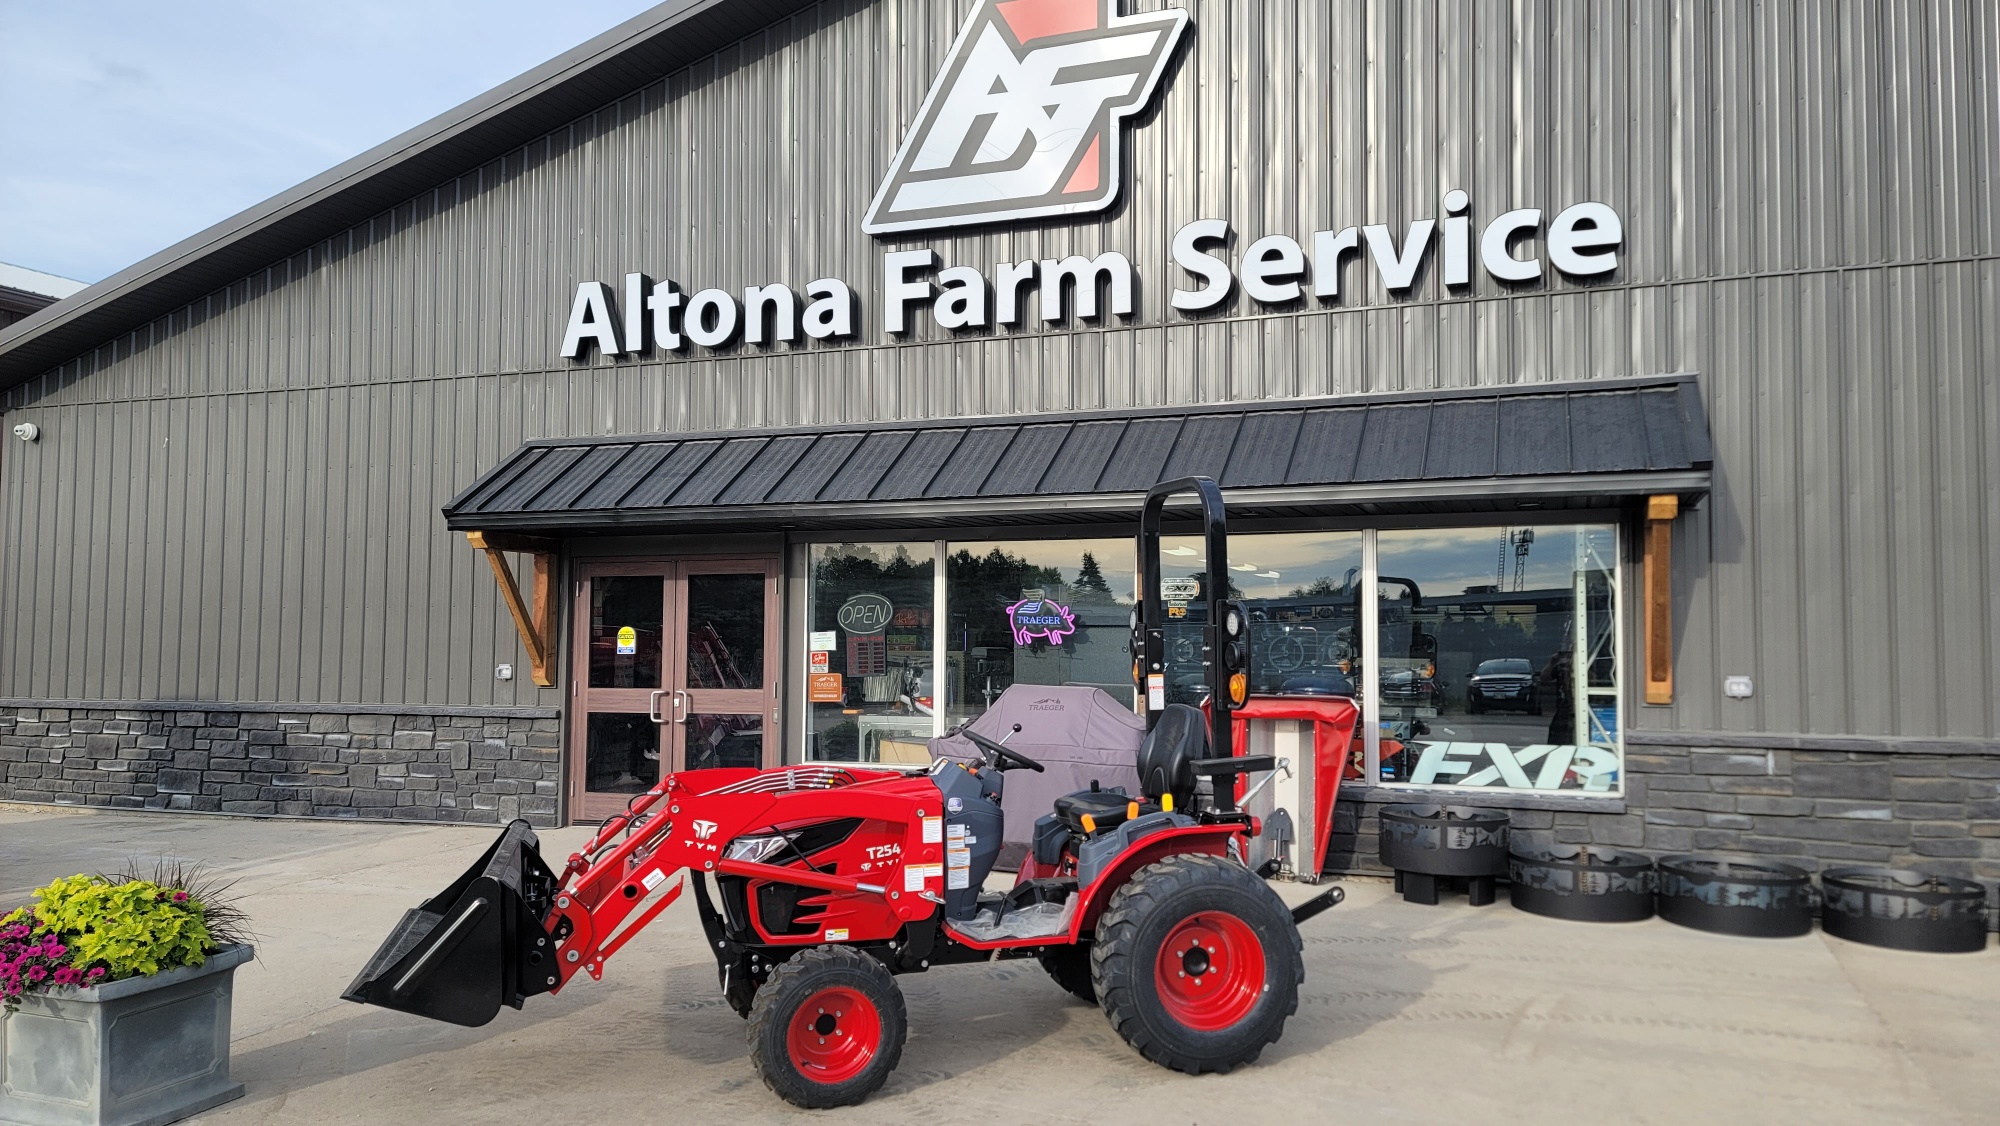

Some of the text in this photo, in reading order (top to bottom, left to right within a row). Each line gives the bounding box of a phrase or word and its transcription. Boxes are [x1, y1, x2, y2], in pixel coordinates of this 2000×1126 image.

[559, 188, 1622, 358] Altona Farm Service
[841, 604, 888, 624] OPEN
[1017, 615, 1061, 625] TRAEGER
[1028, 704, 1065, 712] TRAEGER
[1409, 741, 1620, 792] FXR
[684, 840, 717, 852] TYM
[866, 842, 902, 860] T254
